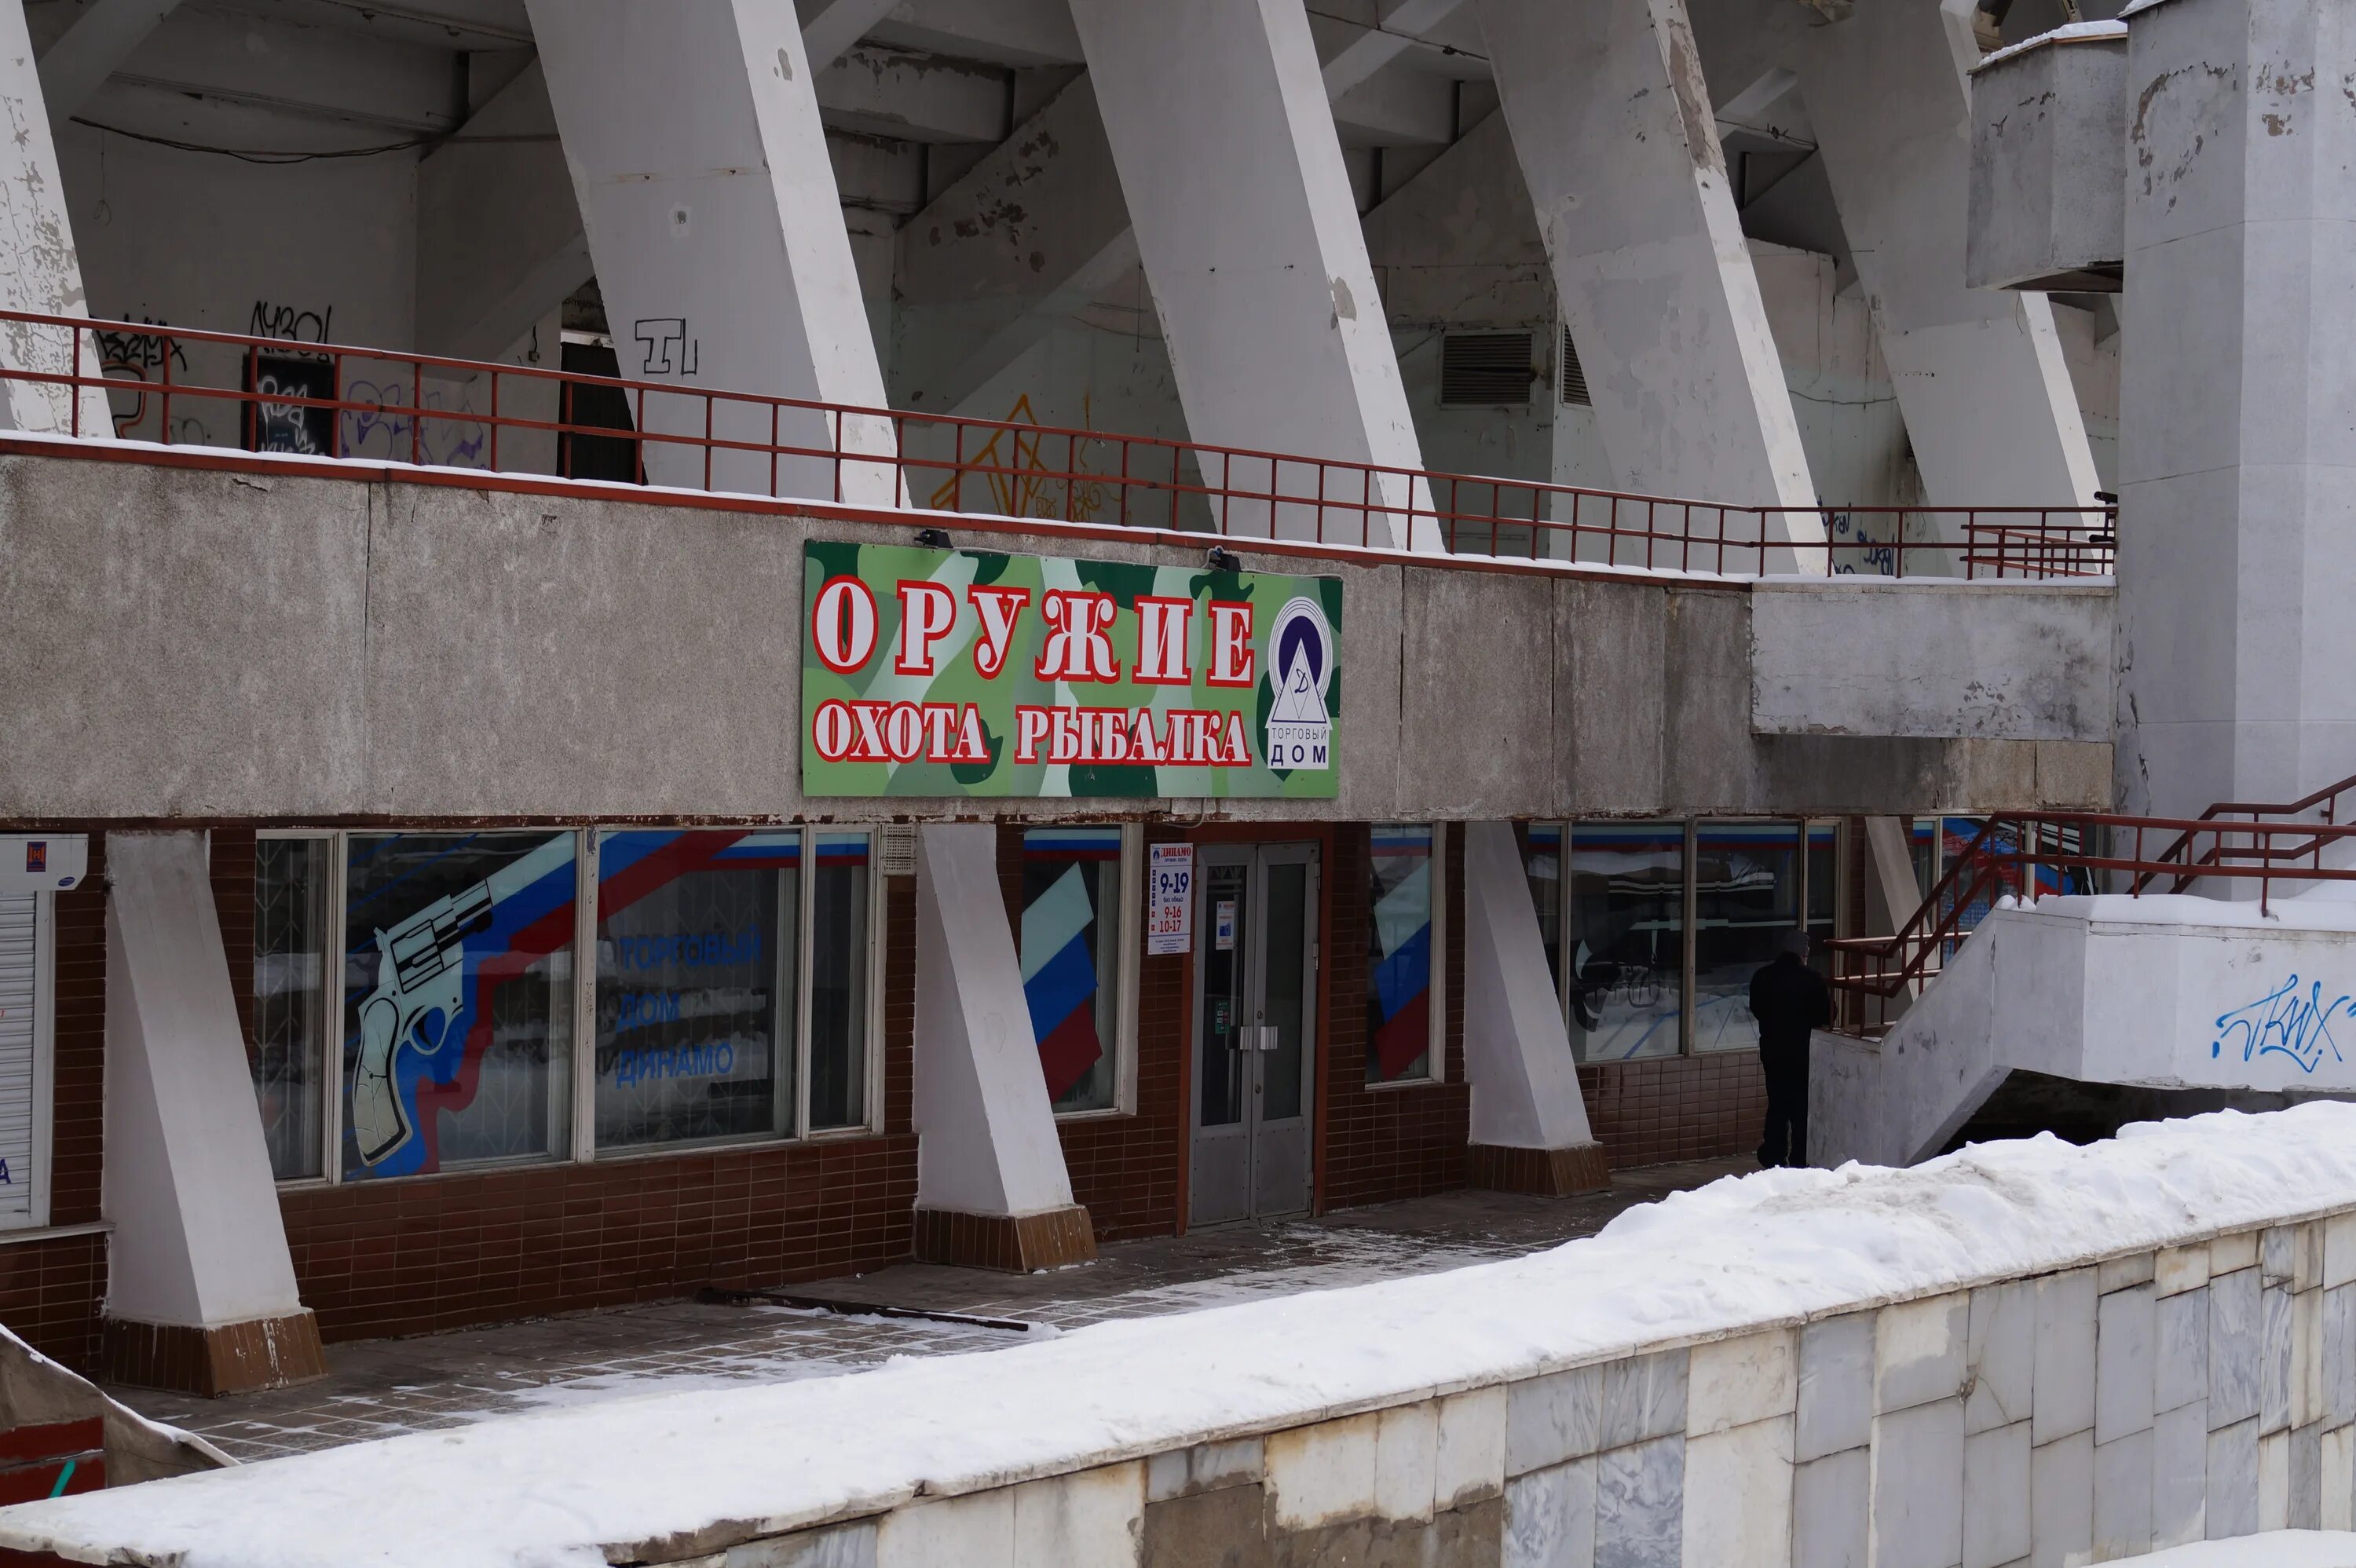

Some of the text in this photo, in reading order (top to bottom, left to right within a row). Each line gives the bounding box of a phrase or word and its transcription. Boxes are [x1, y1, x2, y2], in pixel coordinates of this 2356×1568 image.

[812, 574, 1256, 687] ОРУЖИЕ
[812, 698, 1252, 767] ОХОТА РЫБАЛКА
[1271, 726, 1327, 740] ТОРГОВЫЙ
[1271, 744, 1326, 766] ДОМ
[1160, 872, 1189, 894] 9-19
[1159, 919, 1182, 933] 10-17
[1164, 905, 1182, 919] 9-16
[618, 923, 762, 970] ТОРГОВЫЙ
[616, 992, 680, 1033] ДОМ
[616, 1042, 734, 1090] ДИНАМО
